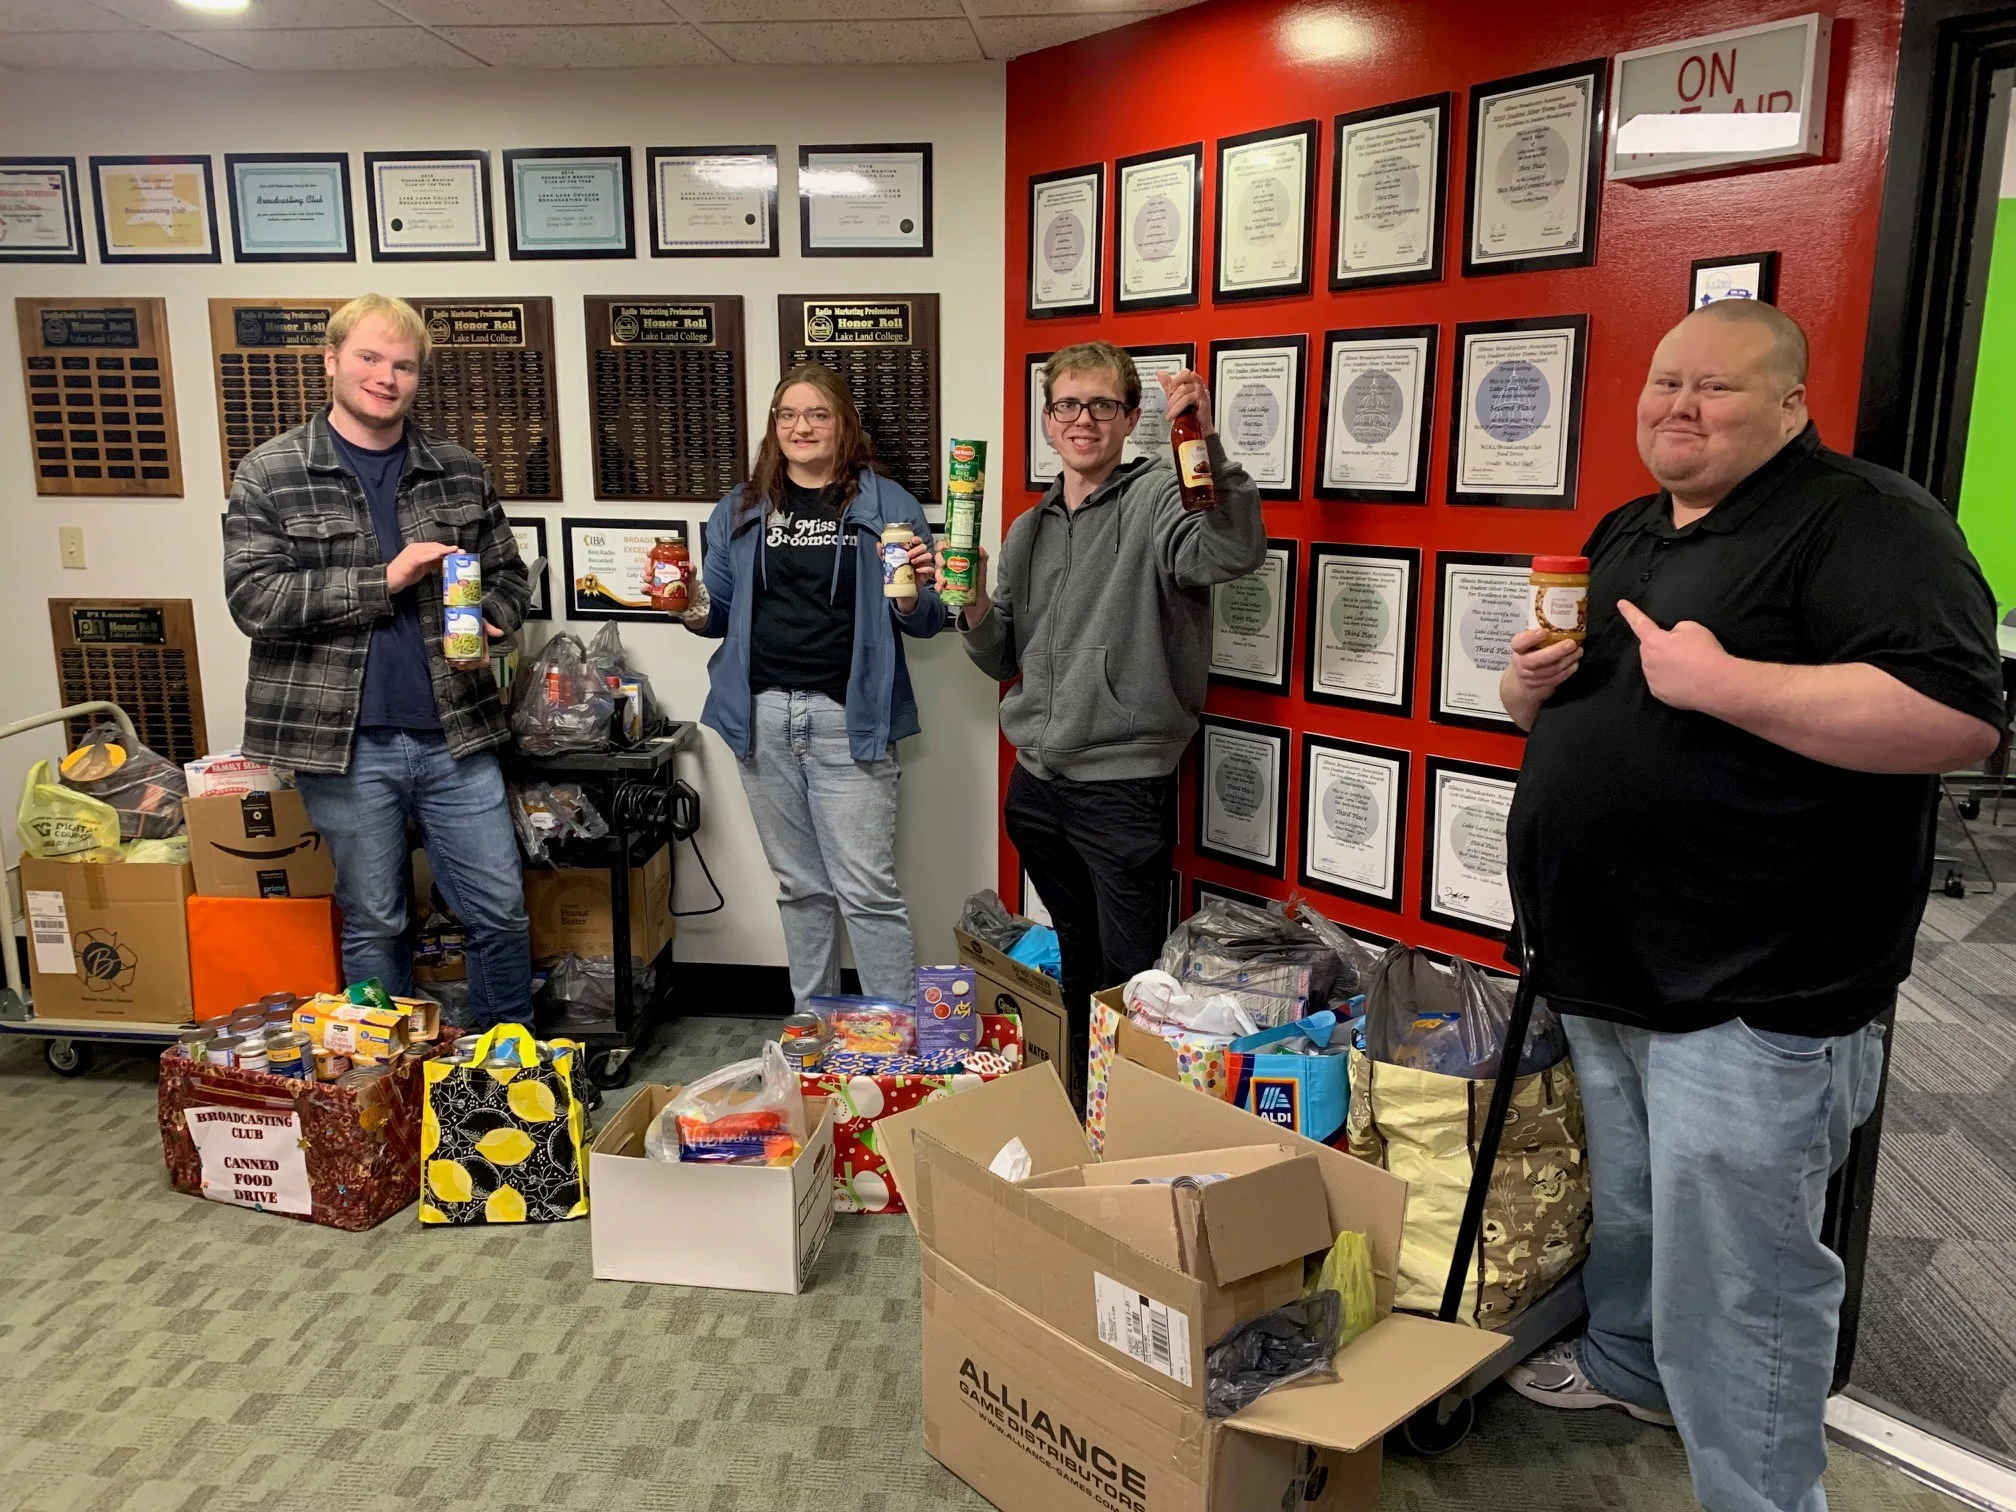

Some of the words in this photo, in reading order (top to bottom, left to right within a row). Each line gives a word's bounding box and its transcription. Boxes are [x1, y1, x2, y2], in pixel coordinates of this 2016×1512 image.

[1678, 48, 1737, 102] ON
[256, 196, 303, 206] Broadcasting
[306, 195, 323, 204] Club
[451, 310, 479, 318] Marketing
[640, 308, 668, 316] Marketing
[835, 307, 864, 316] Marketing
[865, 307, 899, 315] Professional
[266, 322, 298, 331] Honor
[304, 322, 325, 331] Roll
[455, 321, 488, 329] Honor
[494, 321, 516, 329] Roll
[643, 319, 678, 327] Honor
[684, 318, 707, 327] Roll
[838, 318, 874, 327] Honor
[879, 318, 902, 327] Roll
[282, 335, 299, 343] Land
[453, 334, 469, 342] Lake
[471, 334, 489, 342] Land
[490, 334, 517, 344] College
[641, 332, 658, 340] Lake
[661, 332, 678, 340] Land
[680, 332, 707, 342] College
[835, 332, 853, 340] Lake
[855, 332, 873, 340] Land
[875, 332, 903, 342] College
[1490, 404, 1514, 412] Second
[1517, 404, 1536, 412] Place
[795, 518, 836, 536] Miss
[590, 536, 605, 545] IBA
[766, 528, 857, 547] Broomcorn
[109, 622, 137, 631] Honor
[1361, 631, 1377, 639] Place
[1475, 645, 1494, 654] Third
[212, 762, 241, 773] FAMILY
[243, 761, 260, 771] SIZE
[1466, 788, 1496, 798] Broadcasters
[1462, 821, 1474, 829] Lake
[55, 831, 94, 839] COUPO
[264, 885, 286, 894] prime
[561, 909, 588, 917] Peanut
[561, 918, 586, 926] Butter
[997, 997, 1018, 1014] Great
[1028, 1042, 1050, 1061] WATER
[195, 1112, 293, 1128] BROADCASTING
[1260, 1112, 1291, 1123] ALDI
[231, 1127, 264, 1140] CLUB
[224, 1156, 279, 1171] CANNED
[234, 1173, 273, 1187] FOOD
[234, 1189, 278, 1204] DRIVE
[959, 1357, 1146, 1501] ALLIANCE
[959, 1380, 1004, 1422] GAME
[1007, 1416, 1146, 1512] DISTRIBUTORS
[978, 1412, 1120, 1512] WWW.ALLIANCE-GAMES.COM
